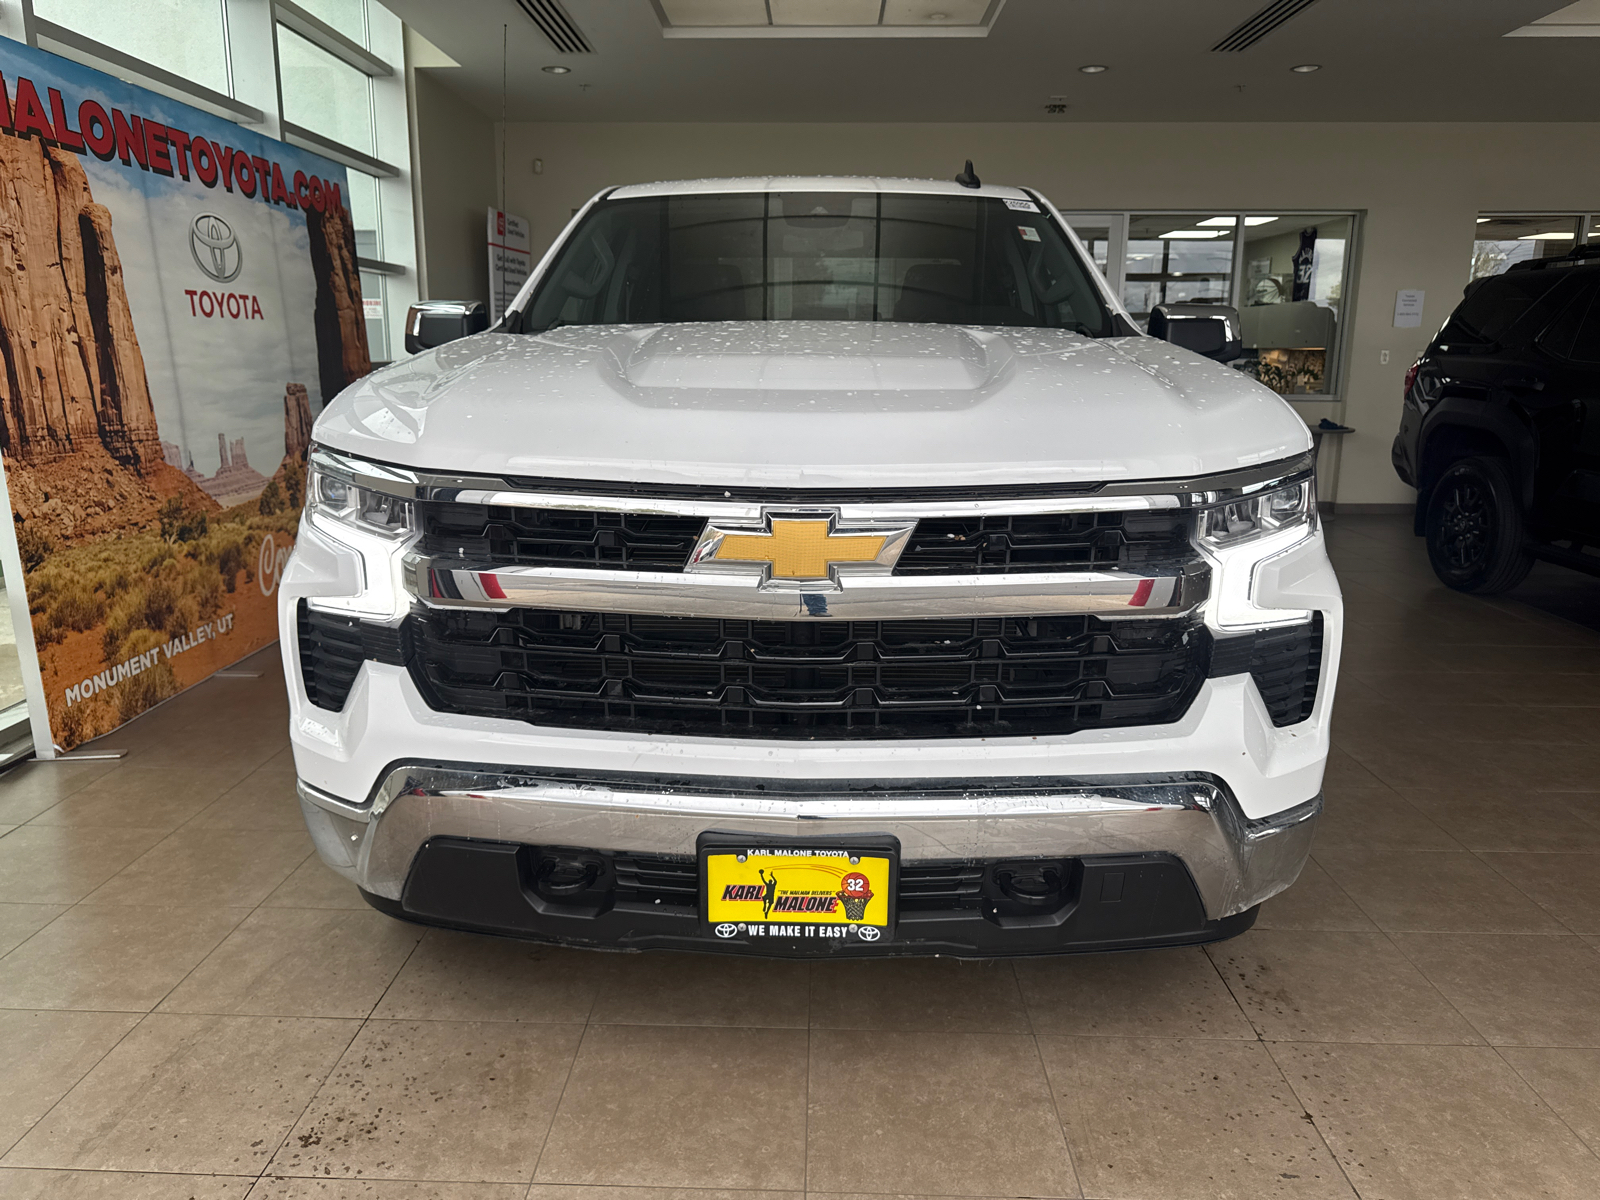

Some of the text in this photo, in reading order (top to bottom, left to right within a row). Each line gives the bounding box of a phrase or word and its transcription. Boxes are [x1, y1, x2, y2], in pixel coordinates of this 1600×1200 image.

[185, 289, 264, 320] TOYOTA
[65, 613, 234, 707] MONUMENT VALLEY, UT
[747, 849, 772, 857] KARL
[814, 850, 849, 858] TOYOTA
[721, 884, 765, 901] KARL
[847, 878, 864, 892] 32
[773, 896, 839, 913] MALONE
[748, 925, 848, 938] WE MAKE IT EASY
